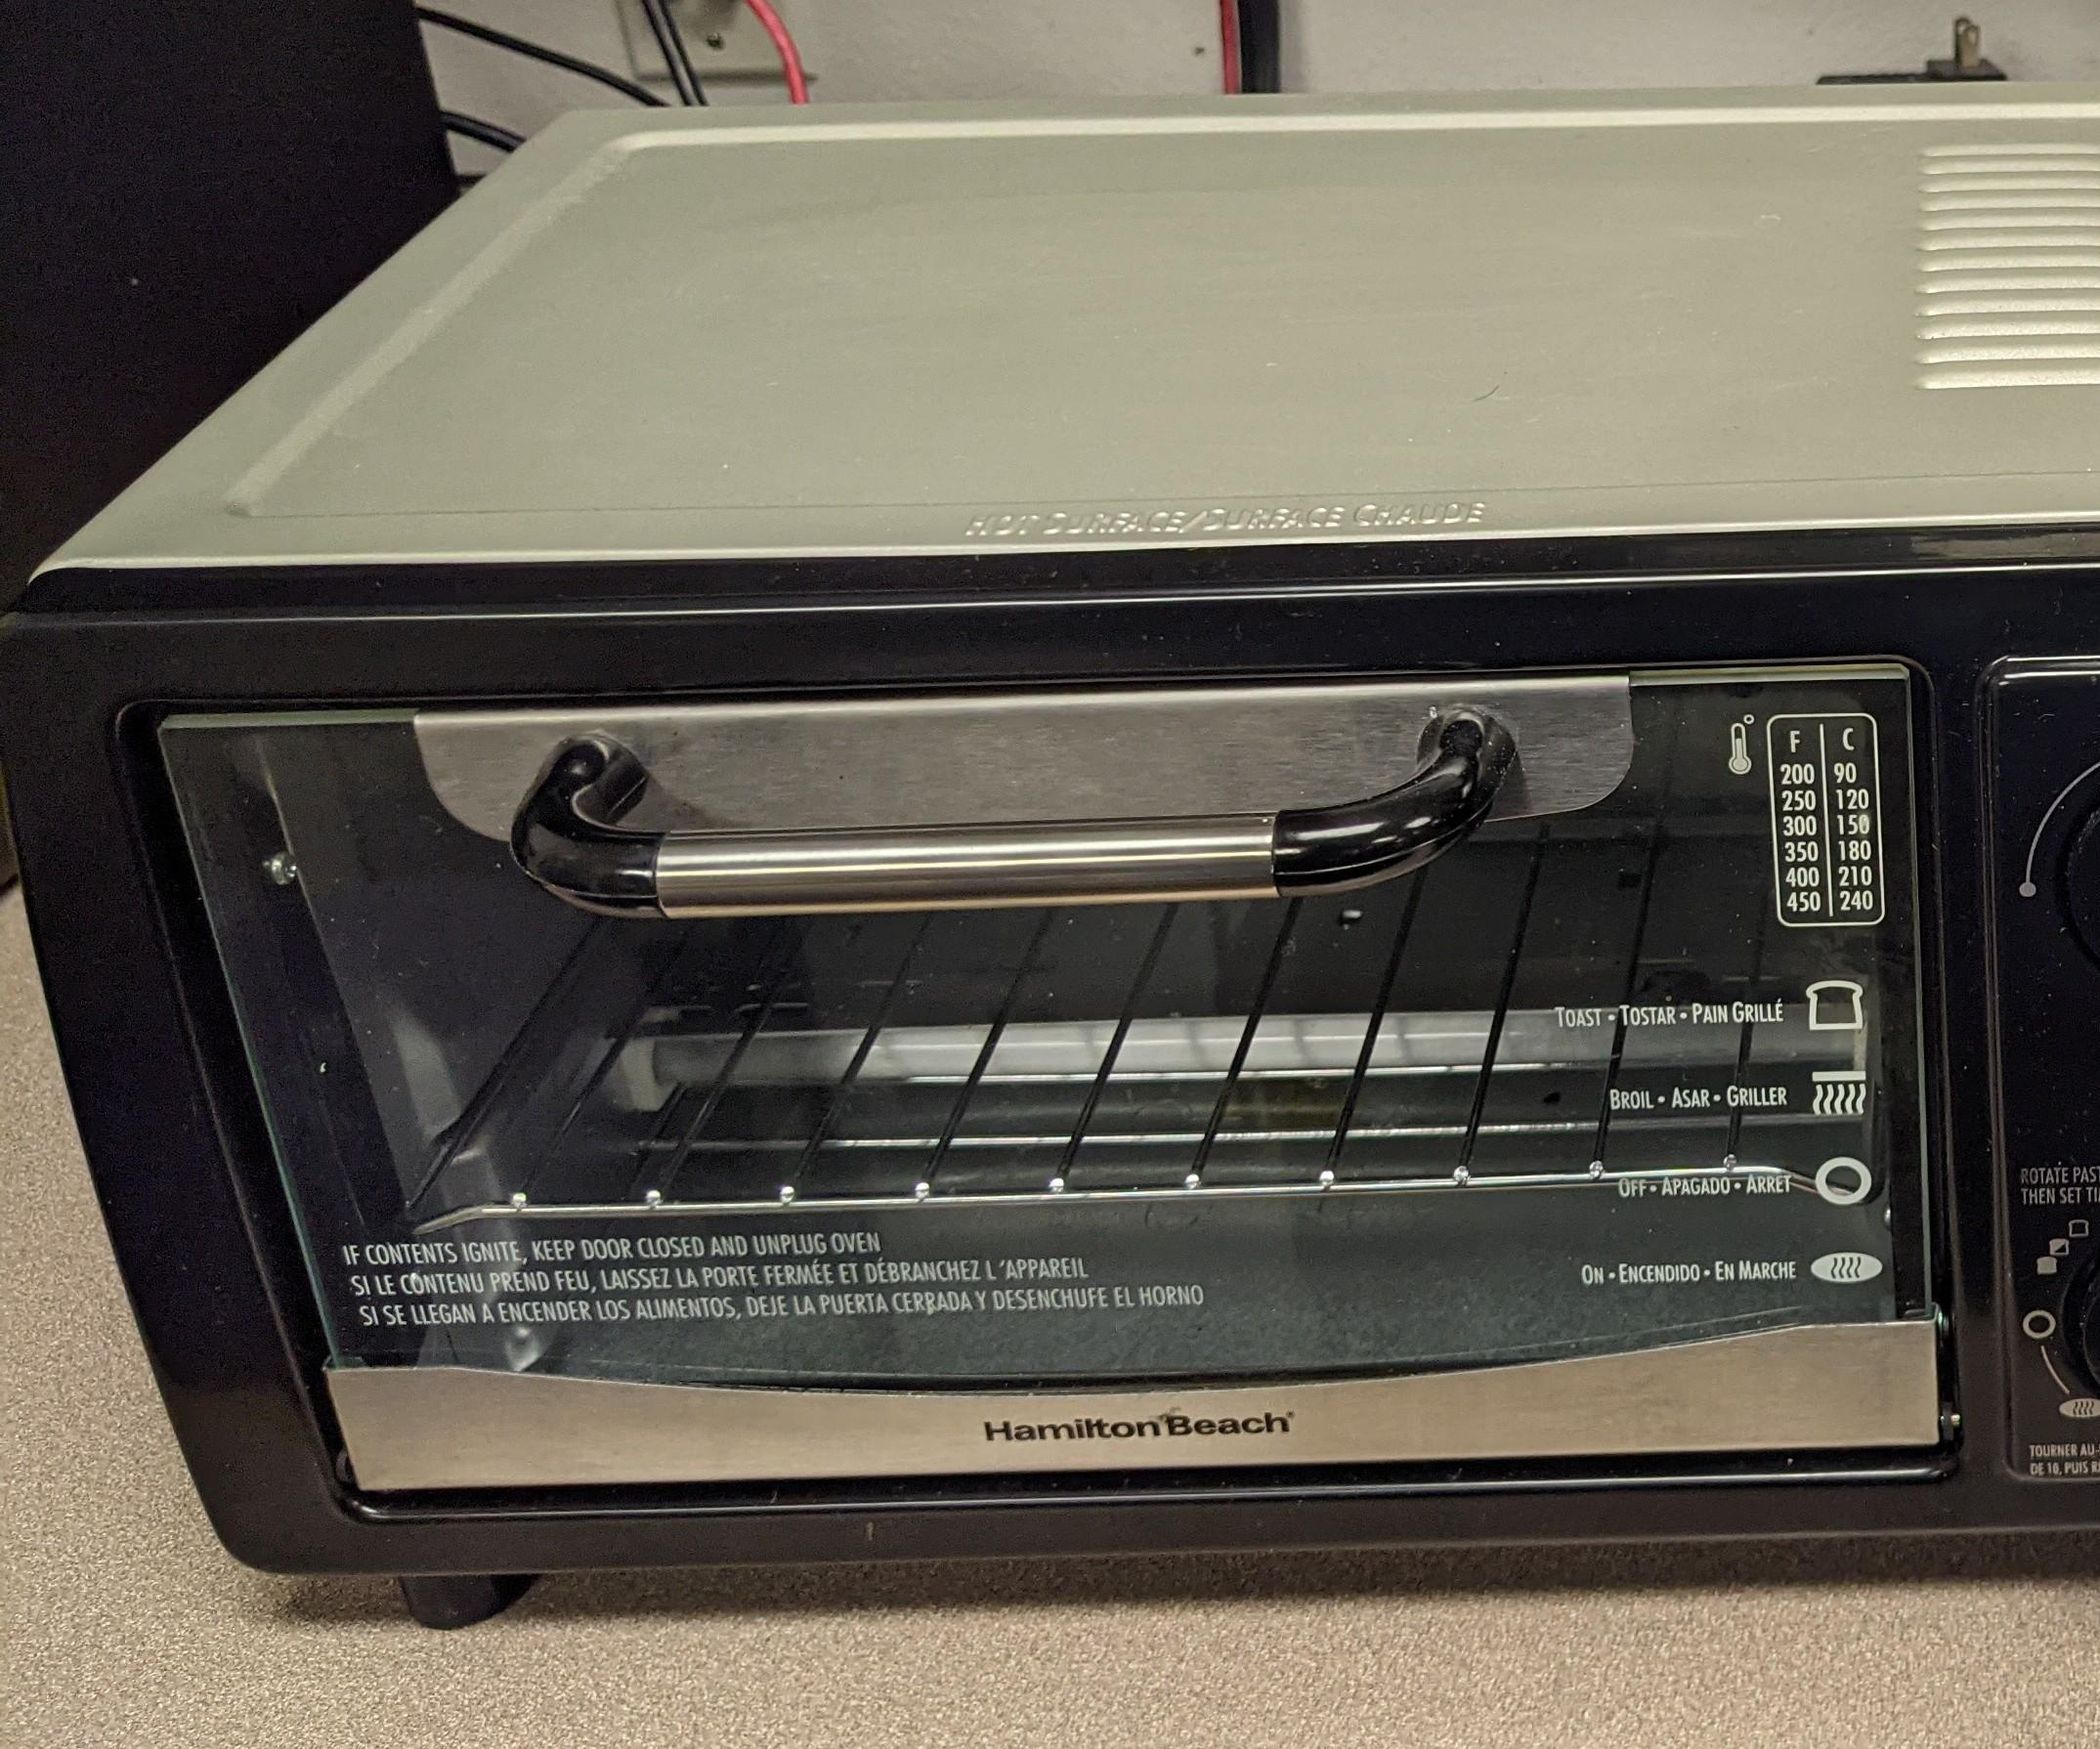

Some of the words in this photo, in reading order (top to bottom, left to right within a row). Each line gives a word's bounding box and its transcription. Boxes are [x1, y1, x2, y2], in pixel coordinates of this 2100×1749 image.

[1352, 502, 1486, 528] CHAUDE
[1789, 730, 1800, 753] F
[1842, 728, 1854, 751] C
[1780, 764, 1815, 785] 200
[1834, 763, 1856, 783] 90
[1782, 790, 1816, 811] 250
[1836, 789, 1869, 809] 120
[1783, 815, 1817, 836] 300
[1837, 814, 1870, 835] 150
[1784, 842, 1818, 862] 350
[1838, 840, 1871, 861] 180
[1785, 867, 1819, 887] 400
[1839, 866, 1872, 886] 210
[1787, 892, 1821, 911] 450
[1840, 891, 1873, 911] 240
[2021, 1167, 2069, 1184] ROTATE
[2021, 1188, 2055, 1205] THEN
[2060, 1187, 2082, 1204] SET
[2086, 1186, 2100, 1202] TI
[343, 1245, 359, 1265] IF
[365, 1243, 458, 1265] CONTENTS
[463, 1241, 528, 1265] IGNITE,
[532, 1240, 575, 1261] KEEP
[584, 1238, 633, 1260] DOOR
[637, 1237, 705, 1259] CLOSED
[710, 1236, 748, 1257] AND
[752, 1233, 827, 1257] UNPLUG
[832, 1232, 881, 1253] OVEN
[352, 1275, 370, 1296] SI
[376, 1274, 396, 1296] LE
[400, 1272, 485, 1295] CONTENU
[490, 1270, 549, 1293] PREND
[555, 1269, 596, 1293] FEU,
[601, 1267, 671, 1290] LAISSEZ
[676, 1267, 699, 1288] LA
[704, 1265, 757, 1288] PORTE
[764, 1257, 835, 1287] FERMÉE
[838, 1262, 860, 1283] ET
[865, 1257, 981, 1283] DÉBRANCHEZ
[359, 1305, 379, 1326] SI
[384, 1304, 407, 1326] SE
[412, 1302, 477, 1325] LLEGAN
[482, 1302, 495, 1323] A
[500, 1300, 592, 1323] ENCENDER
[597, 1299, 631, 1320] LOS
[635, 1297, 742, 1321] ALIMENTOS,
[745, 1294, 789, 1317] DEJE
[794, 1293, 816, 1316] LA
[821, 1290, 889, 1314] PUERTA
[893, 1288, 971, 1315] CERRADA
[973, 1288, 988, 1310] Y
[993, 1285, 1108, 1310] DESENCHUFE
[1114, 1285, 1136, 1308] EL
[1139, 1284, 1204, 1306] HORNO
[984, 1418, 1161, 1441] Hamilton
[2029, 1443, 2078, 1458] TOURNER
[2030, 1462, 2045, 1476] DE
[2064, 1460, 2089, 1474] PUIS
